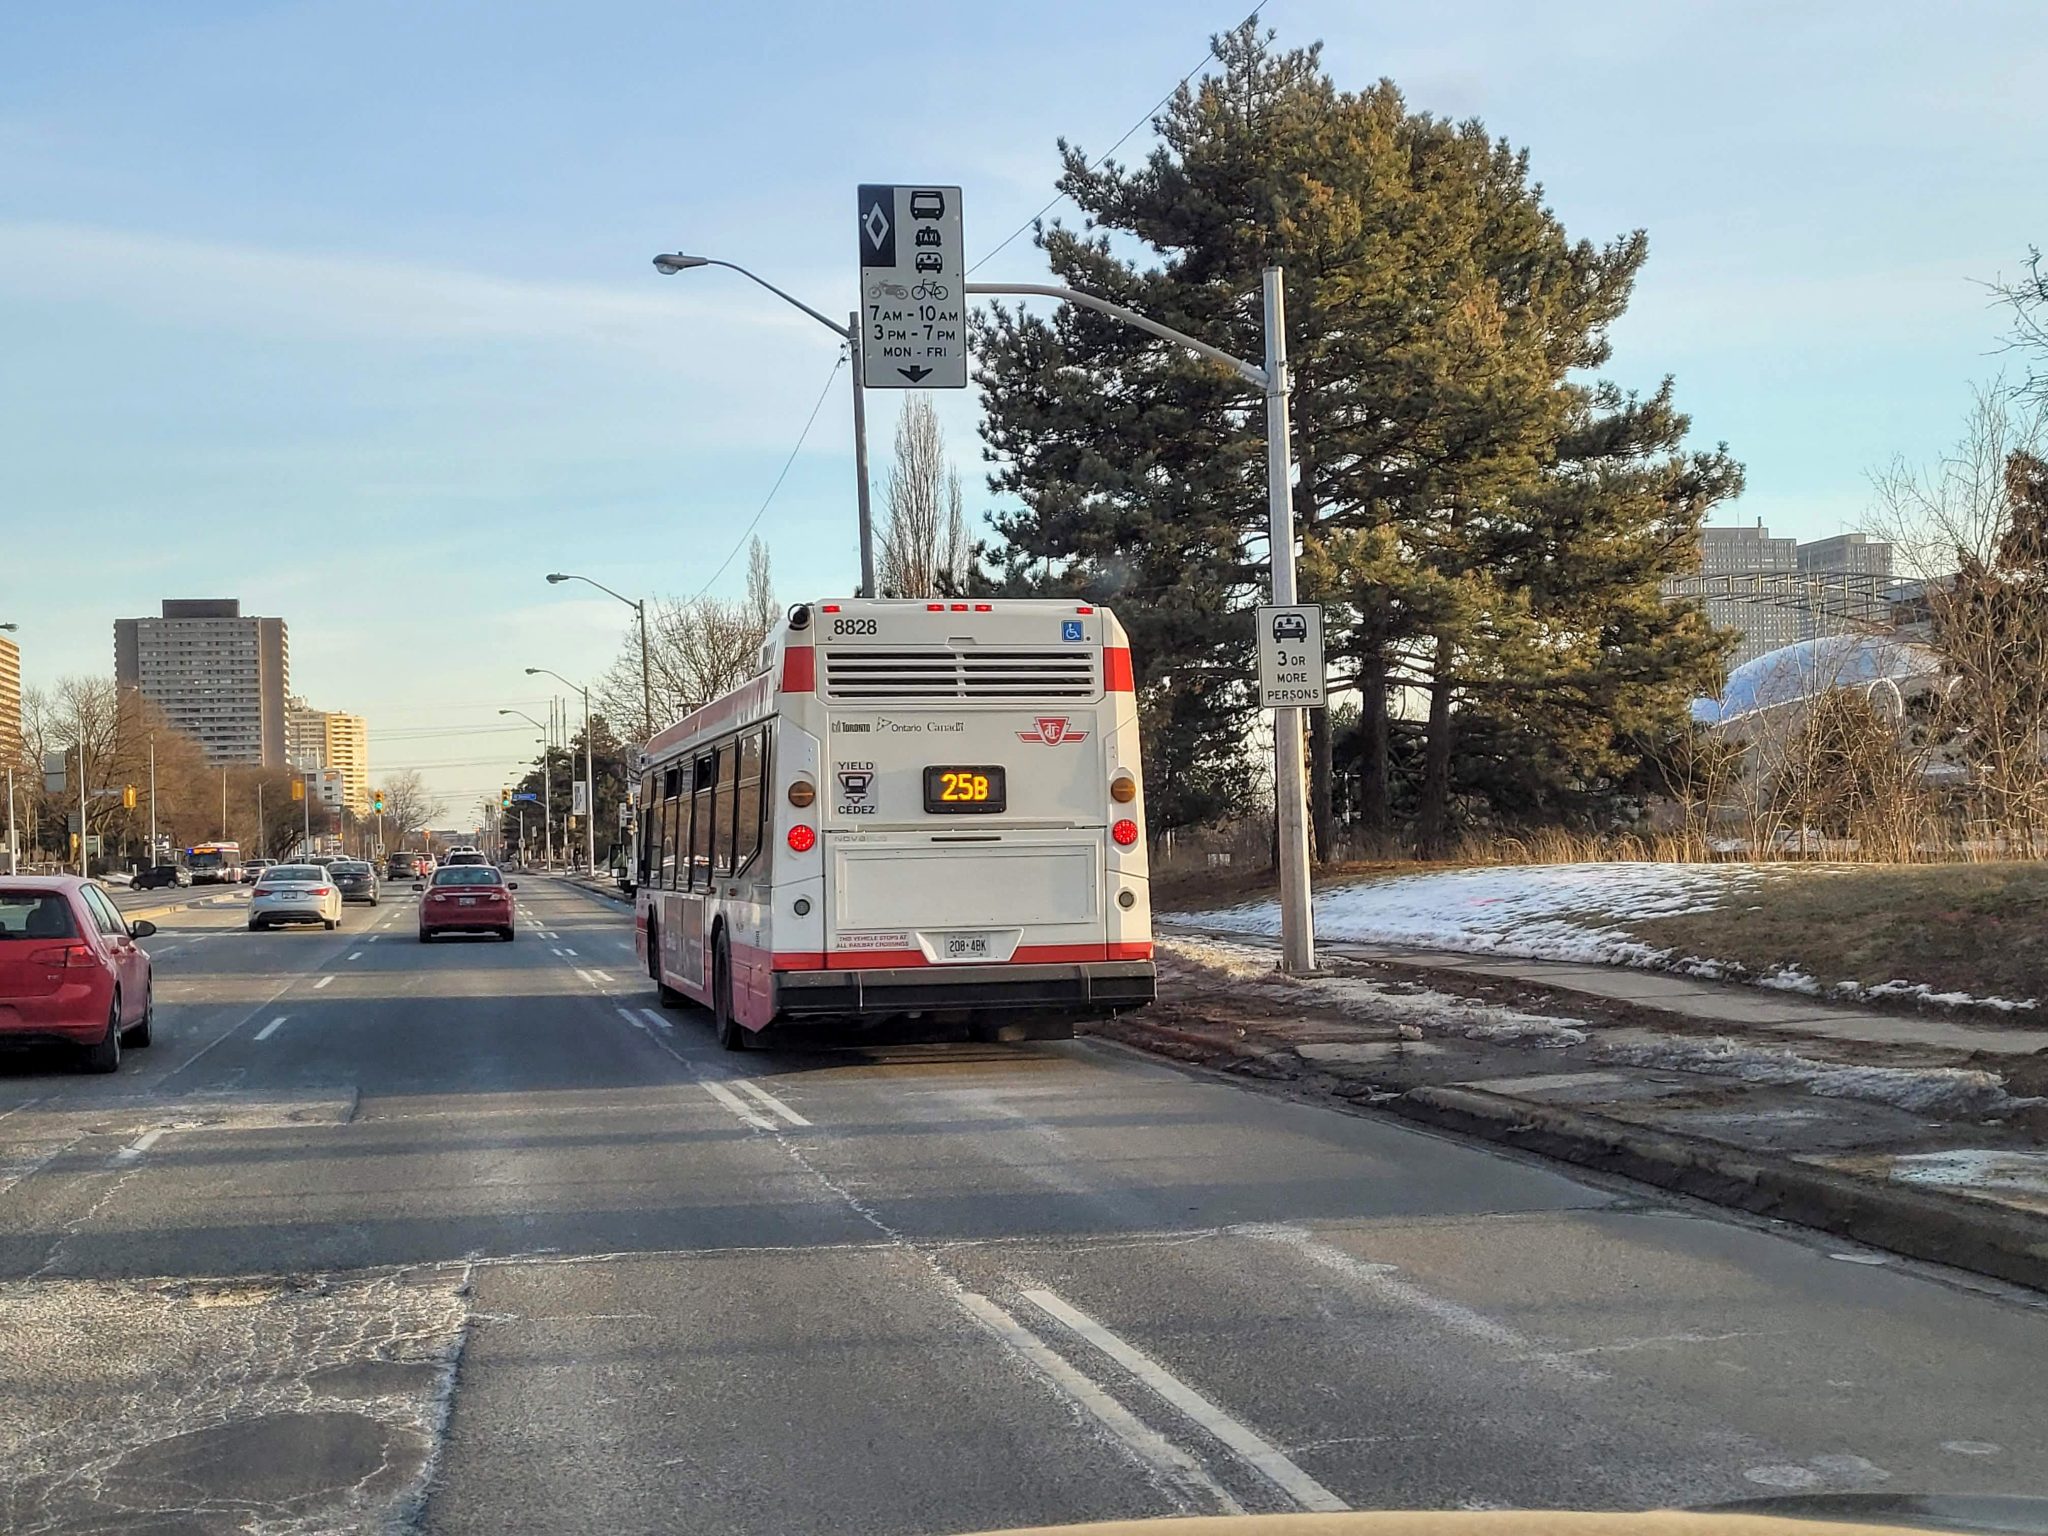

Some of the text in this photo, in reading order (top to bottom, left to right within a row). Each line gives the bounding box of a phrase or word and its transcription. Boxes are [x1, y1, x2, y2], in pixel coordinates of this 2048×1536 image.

[918, 232, 938, 242] TAXI
[869, 305, 880, 321] 7
[882, 311, 902, 321] AM
[919, 306, 936, 321] 10
[938, 311, 958, 321] AM
[874, 325, 884, 341] 3
[888, 331, 906, 341] PM
[923, 325, 933, 341] 7
[937, 331, 955, 341] PM
[883, 347, 912, 357] MON
[927, 347, 947, 357] FRI
[834, 619, 877, 635] 8828
[1277, 650, 1306, 666] 3 OR
[1277, 673, 1308, 683] MORE
[1267, 689, 1319, 700] PERSONS
[891, 723, 922, 732] Ontario
[838, 761, 874, 770] YIELD
[941, 773, 988, 800] 25B
[838, 803, 875, 814] CÉDEZ
